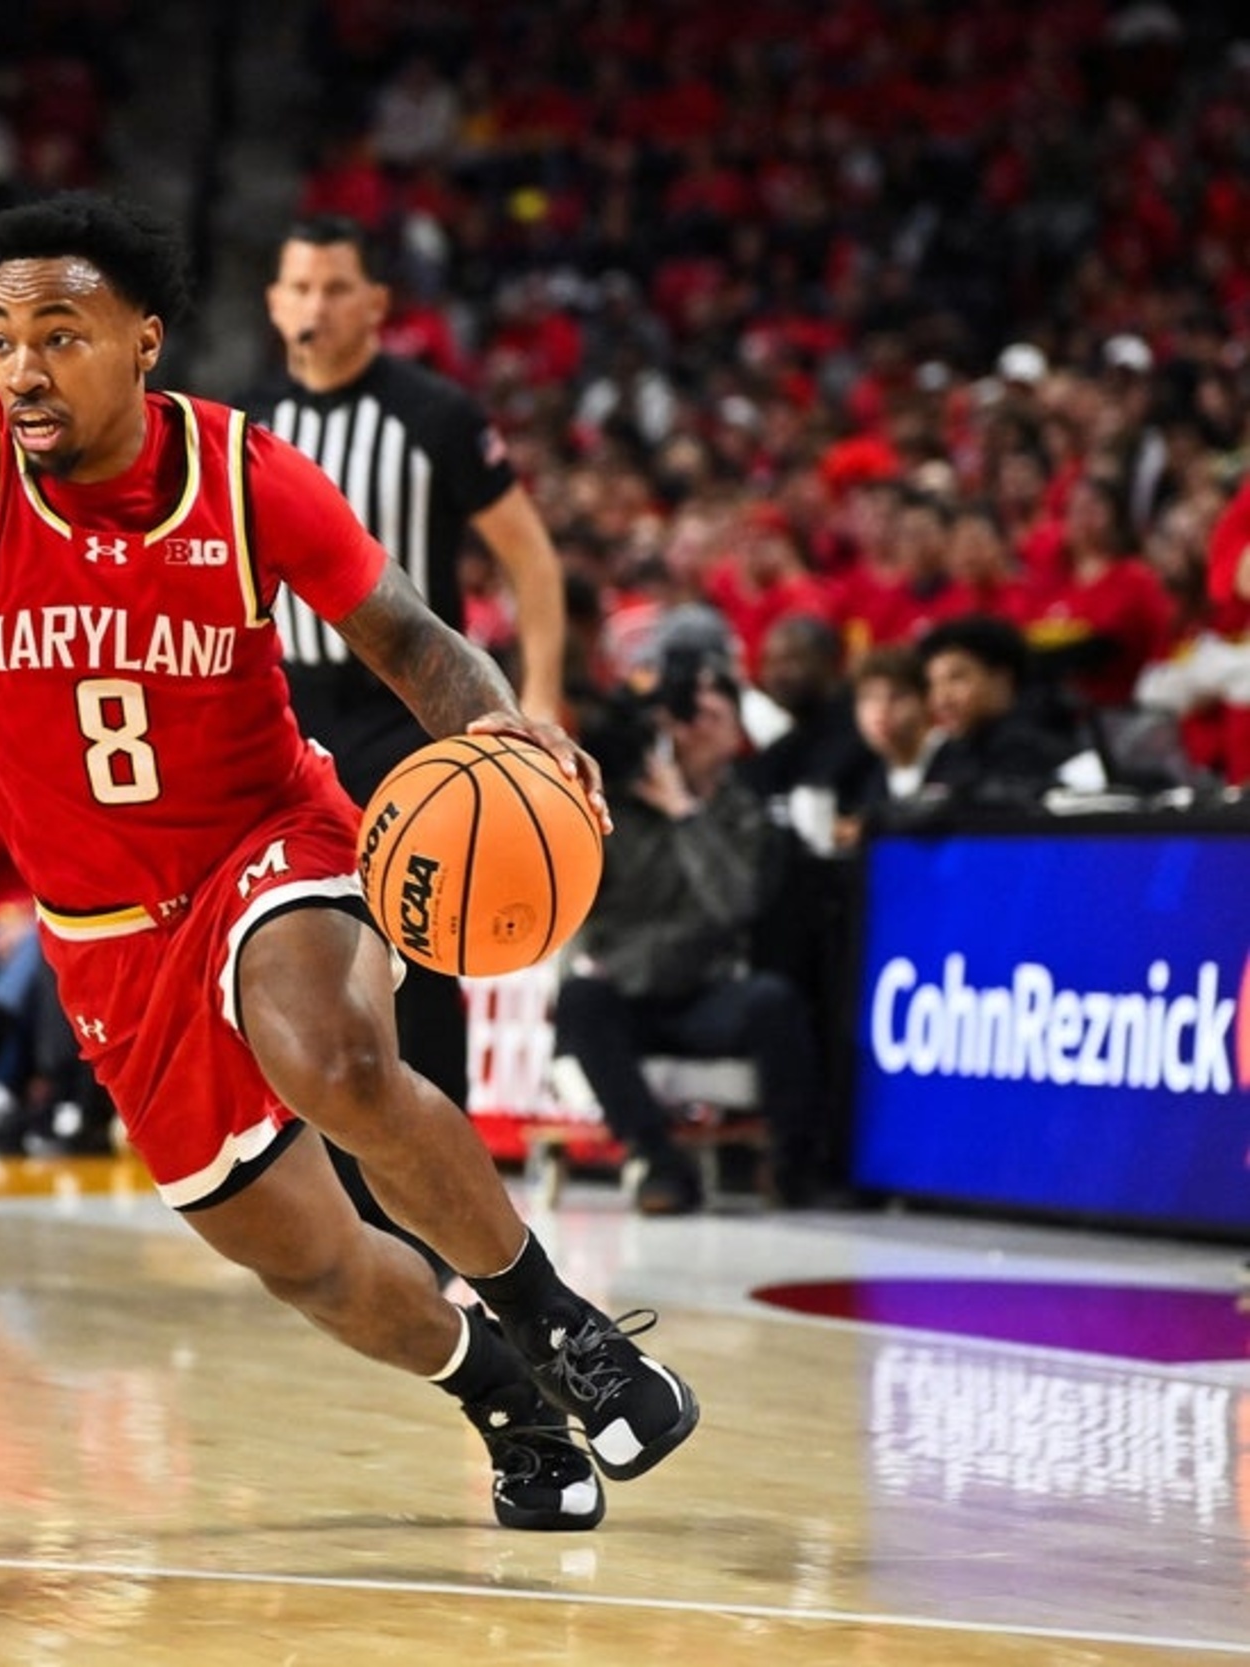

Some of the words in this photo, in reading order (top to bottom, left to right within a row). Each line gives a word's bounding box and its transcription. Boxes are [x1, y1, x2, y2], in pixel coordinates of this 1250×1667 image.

[75, 677, 161, 806] 8
[237, 839, 291, 899] M
[401, 854, 440, 958] NCAA
[871, 952, 1236, 1095] CohnReznick
